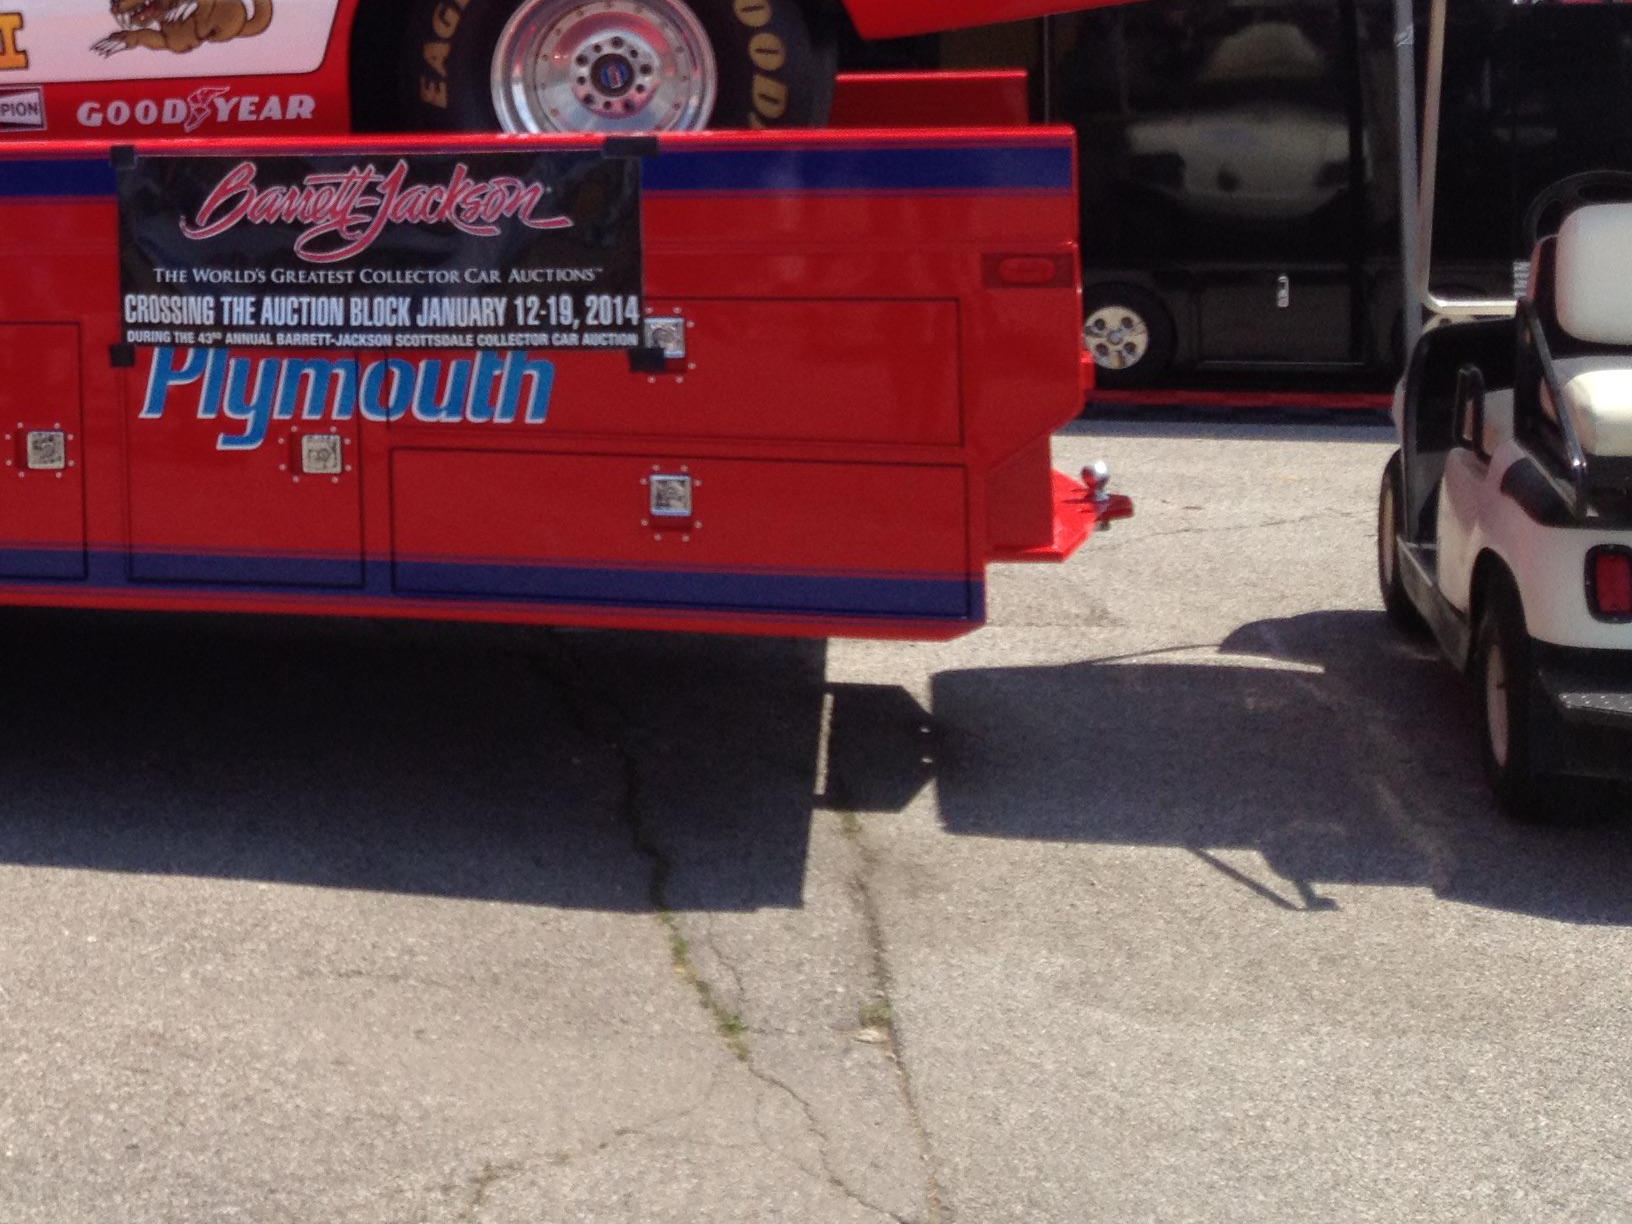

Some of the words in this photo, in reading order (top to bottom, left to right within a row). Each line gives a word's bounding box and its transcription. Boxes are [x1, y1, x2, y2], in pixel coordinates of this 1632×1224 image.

[179, 158, 574, 262] Barrett-Jackson
[153, 267, 188, 283] THE
[192, 267, 266, 284] WORLD'S
[271, 267, 355, 284] GREATEST
[359, 267, 460, 284] COLLECTOR
[464, 267, 502, 284] CAR
[124, 294, 215, 325] CROSSING
[220, 295, 256, 325] THE
[260, 296, 344, 326] AUCTION
[350, 296, 411, 327] BLOCK
[417, 296, 507, 327] JANUARY
[514, 294, 580, 329] 12-19,
[585, 294, 640, 325] 2014
[126, 329, 172, 343] DURING
[173, 330, 195, 343] THE
[225, 331, 271, 345] ANNUAL
[276, 332, 392, 346] BARRETT-JACKSON
[395, 332, 473, 346] SCOTTSDALE
[476, 332, 549, 346] COLLECTOR
[551, 332, 579, 346] CAR
[582, 332, 638, 346] AUCTION
[138, 347, 555, 450] Plymouth
